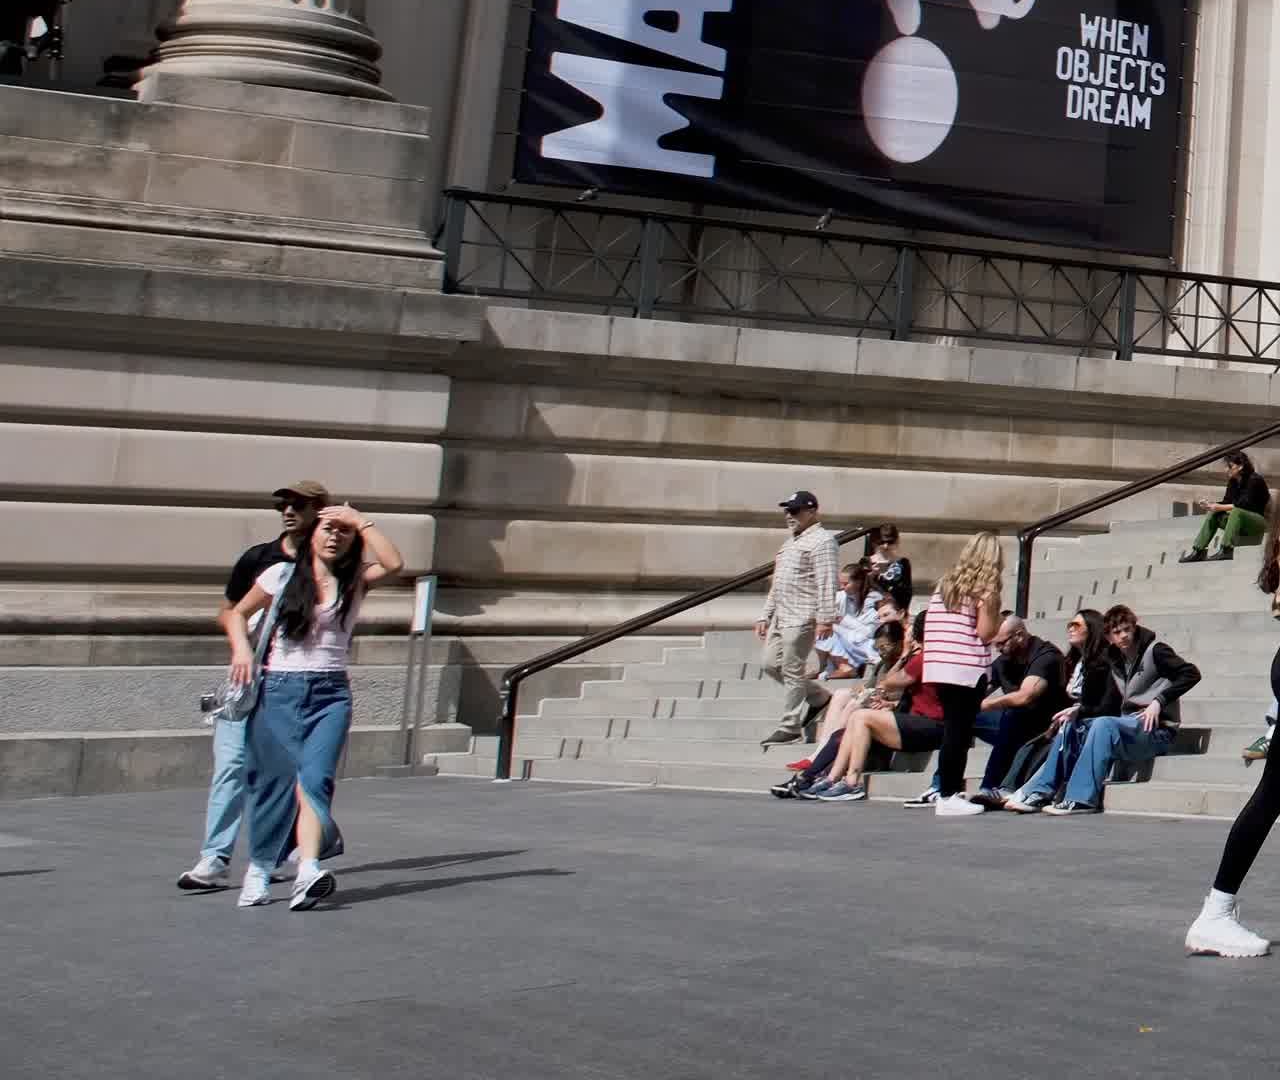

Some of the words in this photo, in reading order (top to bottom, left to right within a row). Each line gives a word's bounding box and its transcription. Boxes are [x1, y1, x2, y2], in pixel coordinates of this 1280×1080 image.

[1080, 13, 1150, 58] WHEN
[1056, 46, 1167, 96] OBJECTS
[1066, 84, 1152, 130] DREAM
